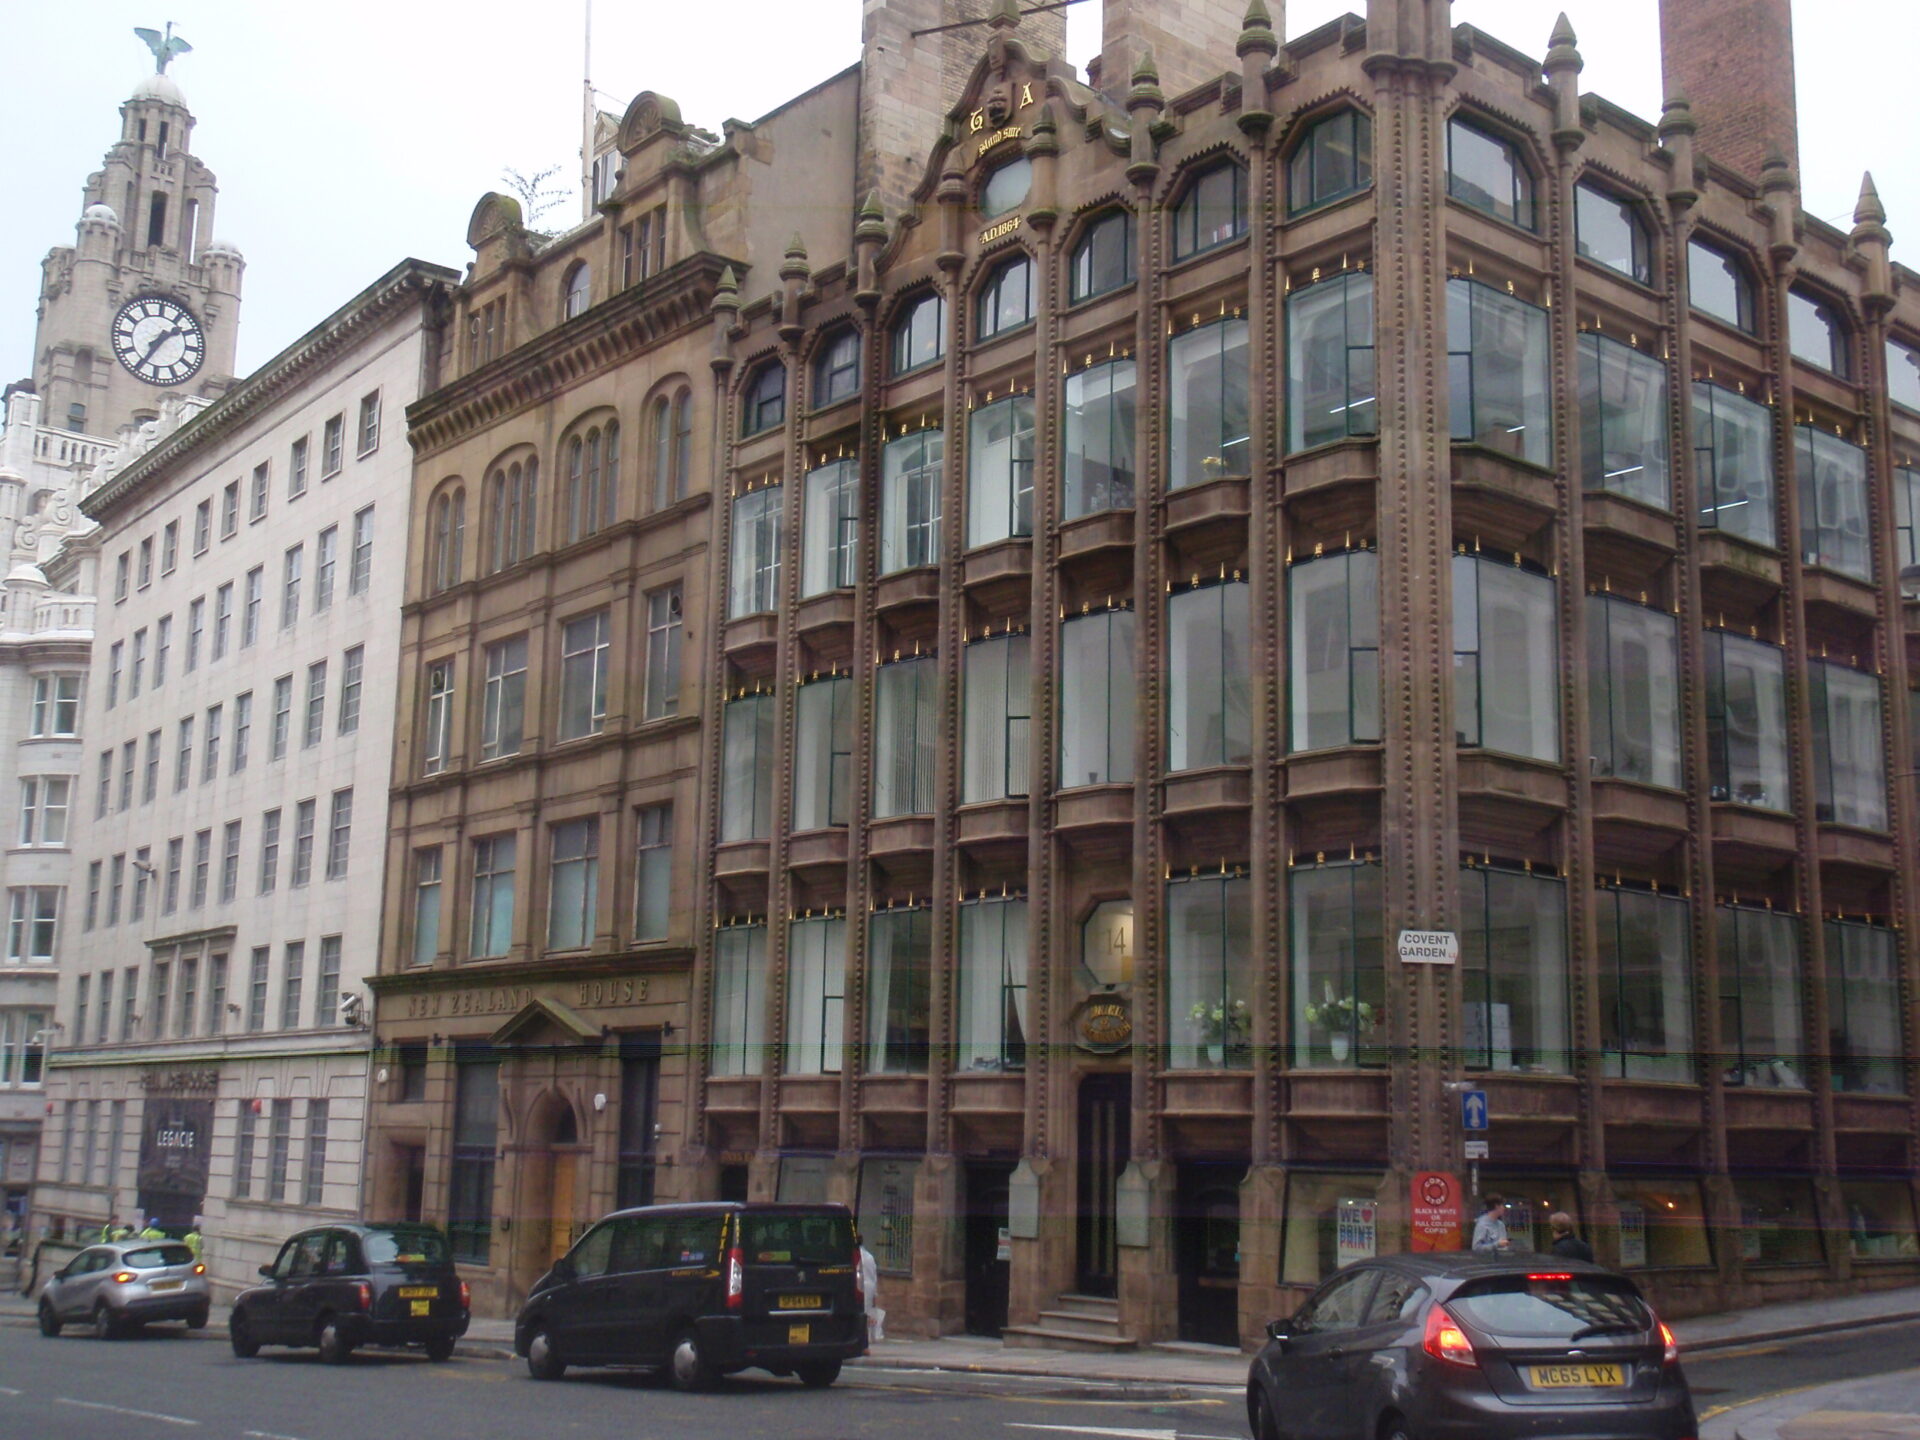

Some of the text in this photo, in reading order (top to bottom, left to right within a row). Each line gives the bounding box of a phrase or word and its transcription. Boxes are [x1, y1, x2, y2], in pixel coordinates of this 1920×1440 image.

[1105, 926, 1127, 956] 14
[1404, 934, 1450, 945] COVENT
[1399, 946, 1447, 958] GARDEN
[451, 988, 535, 1014] ZEALAND
[579, 978, 649, 1006] HOUSE
[157, 1130, 195, 1148] LEGACIE
[1340, 1208, 1361, 1224] WE
[1339, 1224, 1374, 1249] PRINT
[1537, 1366, 1617, 1384] MC65 LYX
